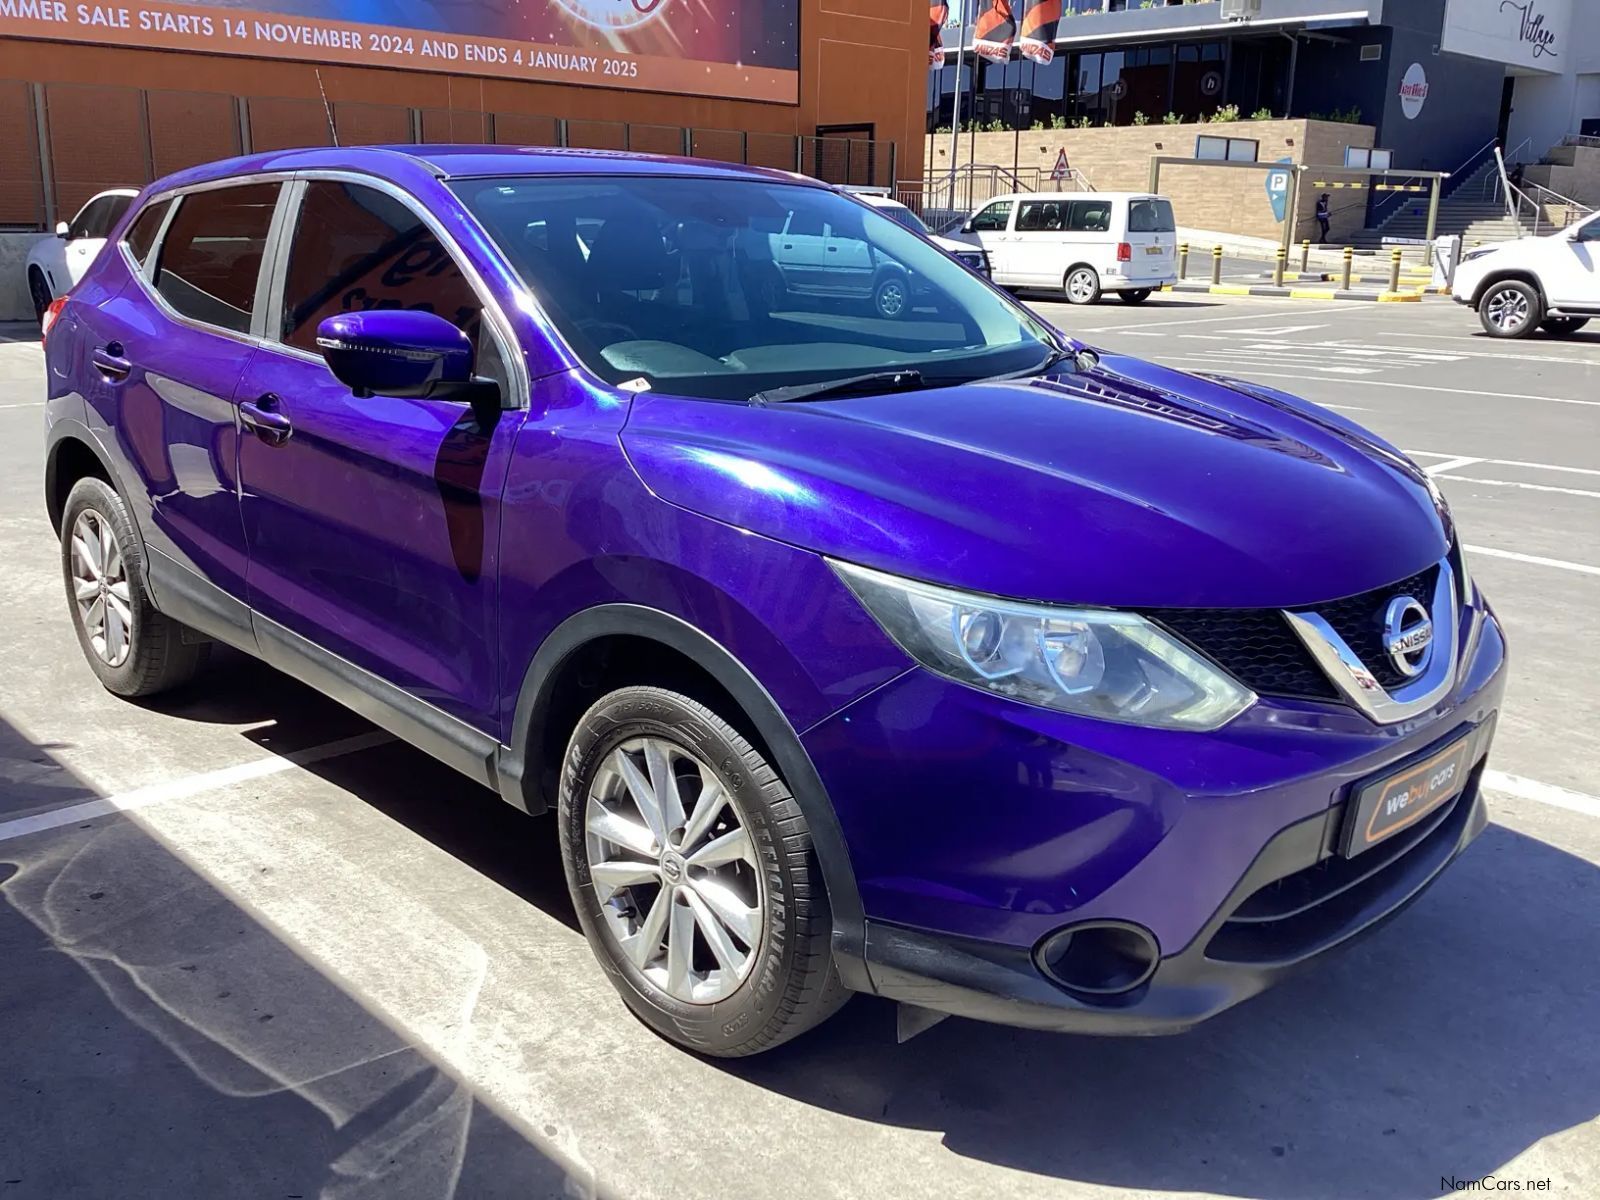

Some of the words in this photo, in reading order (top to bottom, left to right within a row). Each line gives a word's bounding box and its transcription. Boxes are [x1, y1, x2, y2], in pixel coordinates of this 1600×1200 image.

[1499, 0, 1558, 58] Village
[76, 3, 131, 29] SALE
[138, 10, 214, 36] STARTS
[222, 18, 248, 39] 14
[254, 20, 363, 51] NOVEMBER
[368, 33, 415, 55] 2024
[420, 39, 459, 60] AND
[464, 43, 508, 64] ENDS
[512, 49, 523, 66] 4
[527, 50, 598, 74] JANUARY
[602, 58, 638, 78] 2025
[975, 43, 1009, 59] MIDAS
[1020, 42, 1052, 62] MIDAS
[1273, 176, 1284, 190] P
